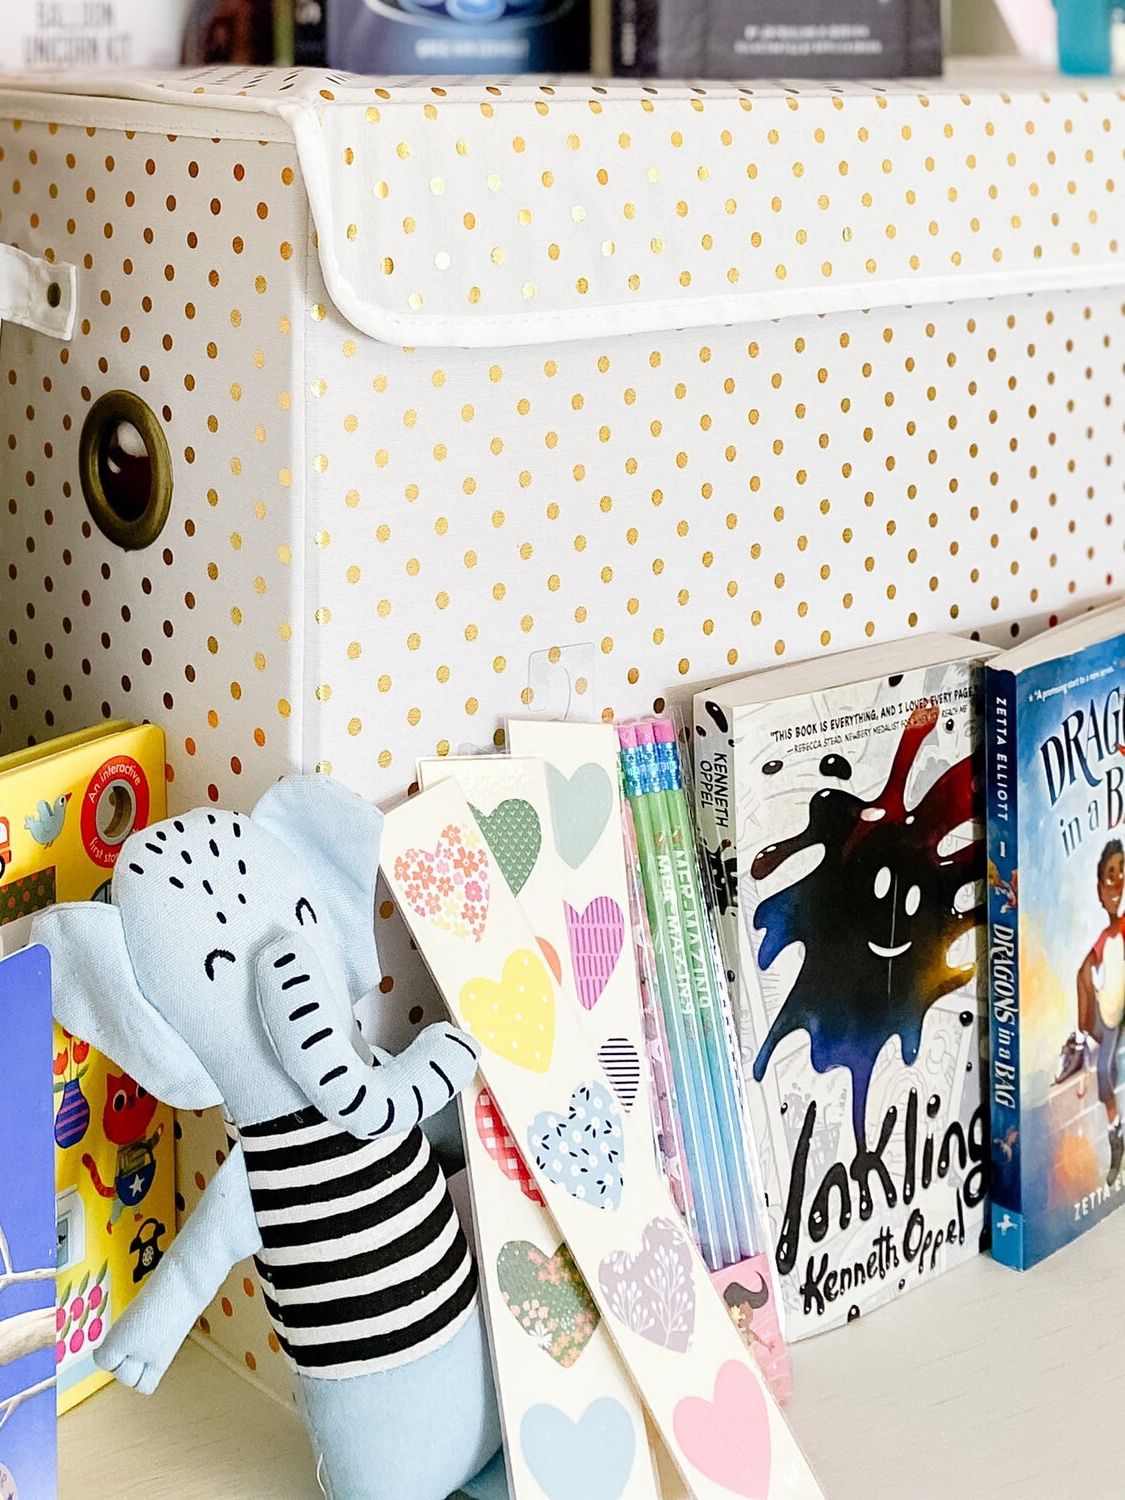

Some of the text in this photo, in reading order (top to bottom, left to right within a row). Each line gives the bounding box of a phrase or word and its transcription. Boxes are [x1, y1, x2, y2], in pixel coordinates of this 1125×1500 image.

[795, 723, 817, 738] BOOK
[819, 719, 828, 732] IS
[830, 709, 879, 729] EVERYTHING,
[880, 704, 896, 718] AND
[898, 703, 903, 714] I
[905, 698, 928, 712] LOVED
[930, 692, 953, 708] EVERY
[844, 728, 871, 743] NEWBERY
[873, 722, 899, 738] MEDALIST
[996, 696, 1008, 821] ZETTA ELLIOTT
[1040, 686, 1125, 808] DRAG
[88, 764, 141, 803] An interactive
[700, 760, 713, 808] OPPEL
[714, 752, 729, 828] KENNETH
[89, 837, 103, 859] first
[1059, 799, 1099, 857] in a
[990, 923, 1019, 1110] DRAGONS in a BAG
[1074, 1184, 1111, 1221] ZETTA
[800, 1187, 965, 1315] Kenneth Oppel
